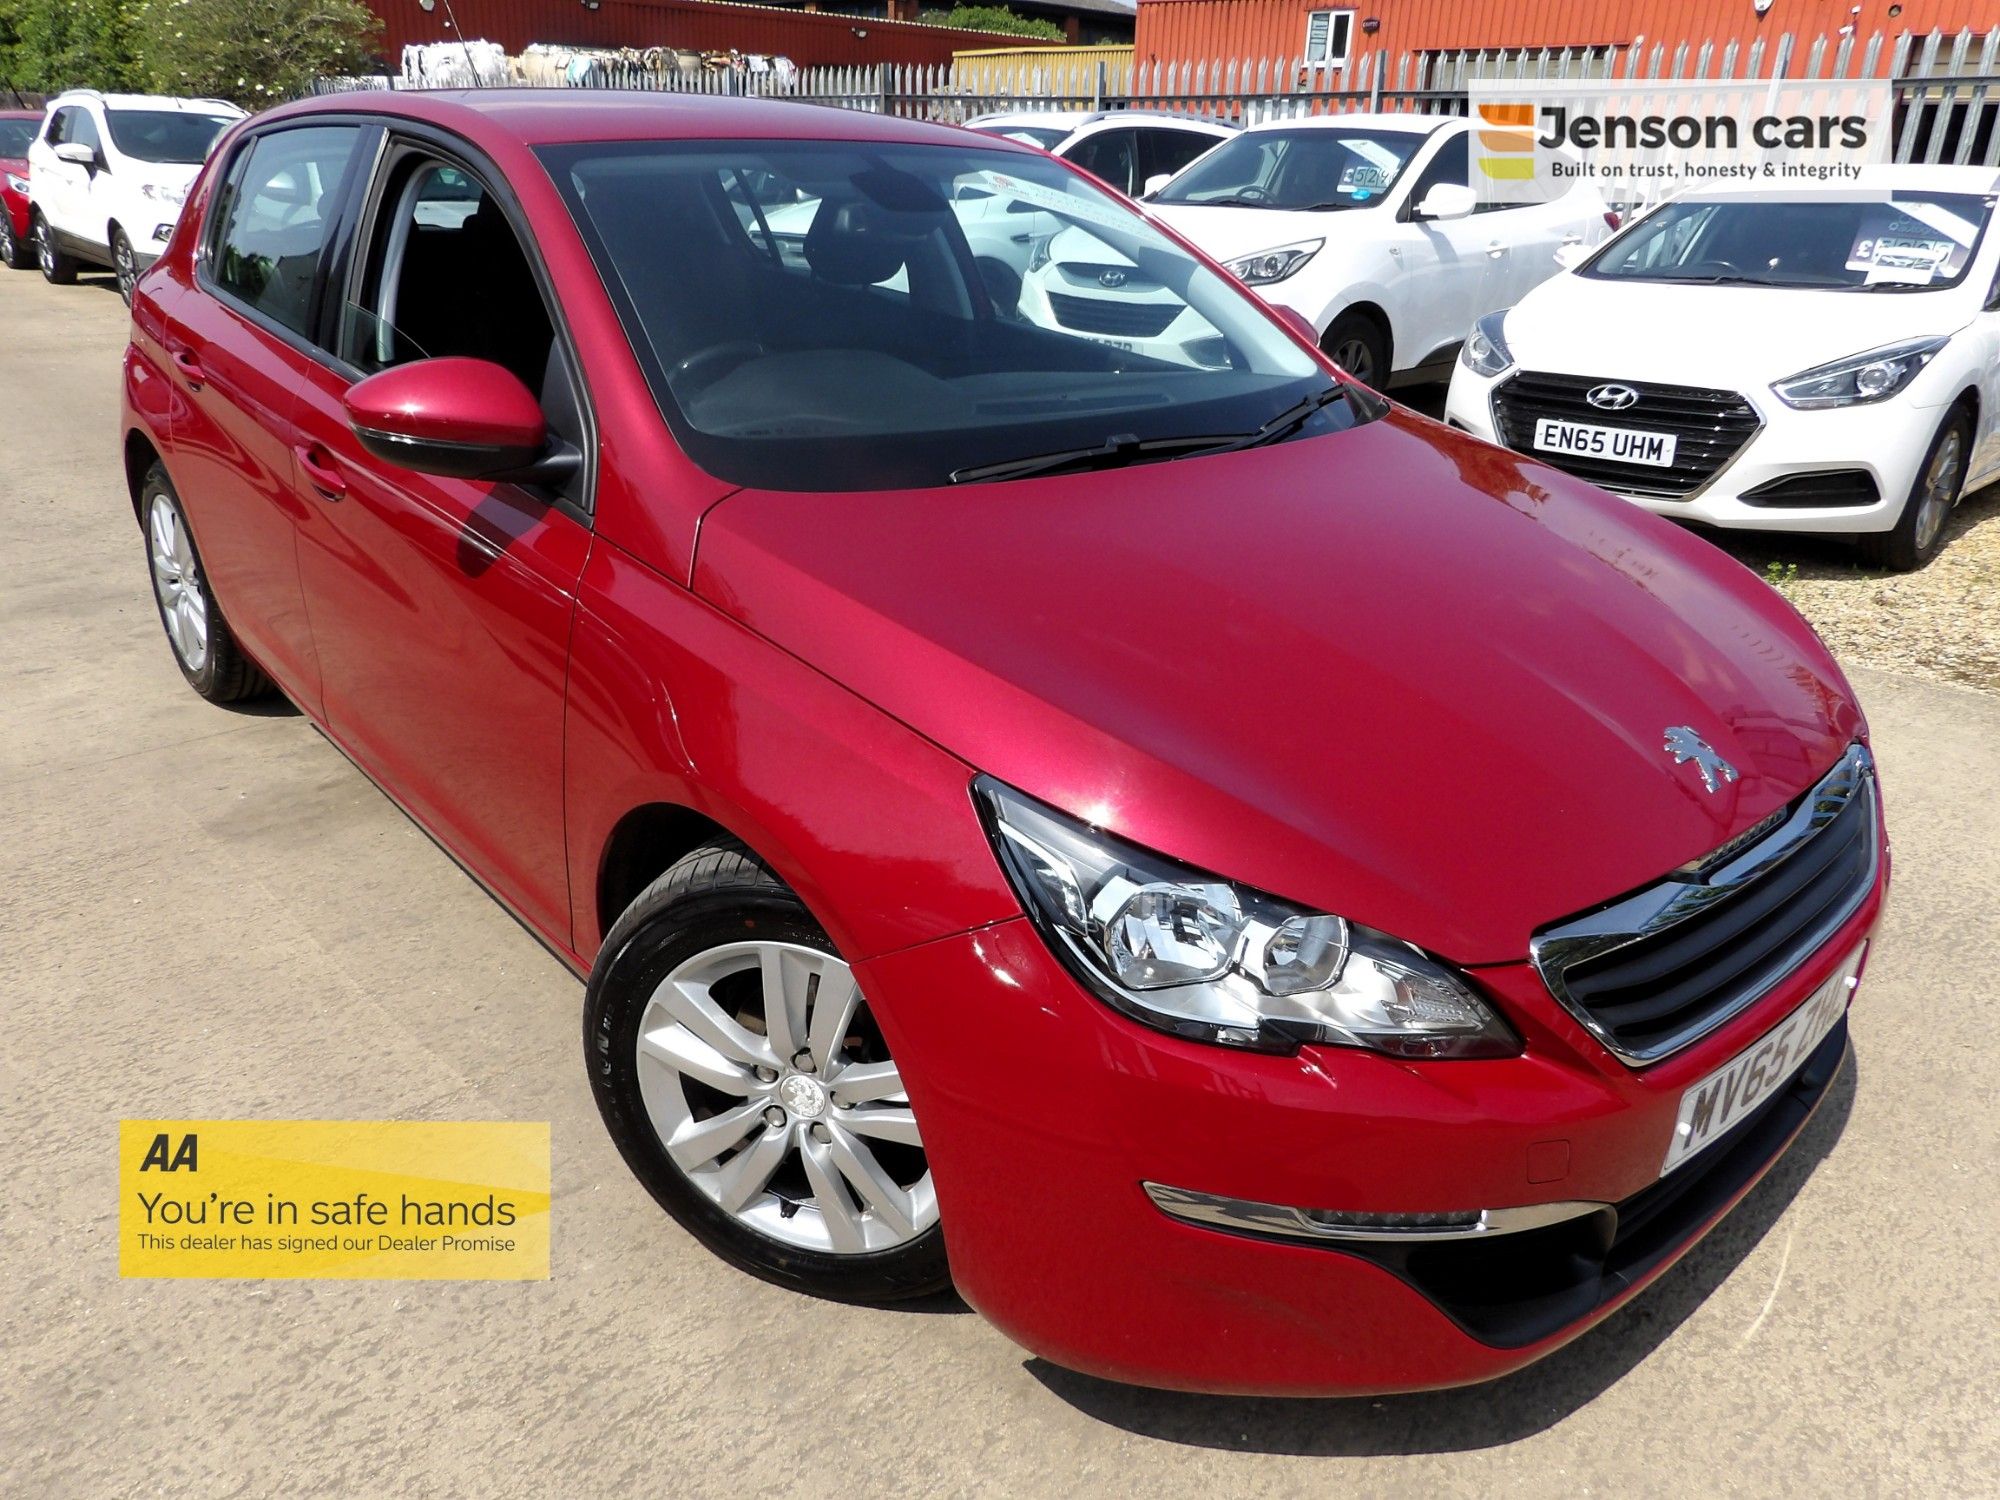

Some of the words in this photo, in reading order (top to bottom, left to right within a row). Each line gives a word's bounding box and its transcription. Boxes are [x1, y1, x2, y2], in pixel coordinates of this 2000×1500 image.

[1543, 424, 1607, 453] EN65
[1612, 433, 1665, 461] UHM
[1683, 1019, 1798, 1152] MV65
